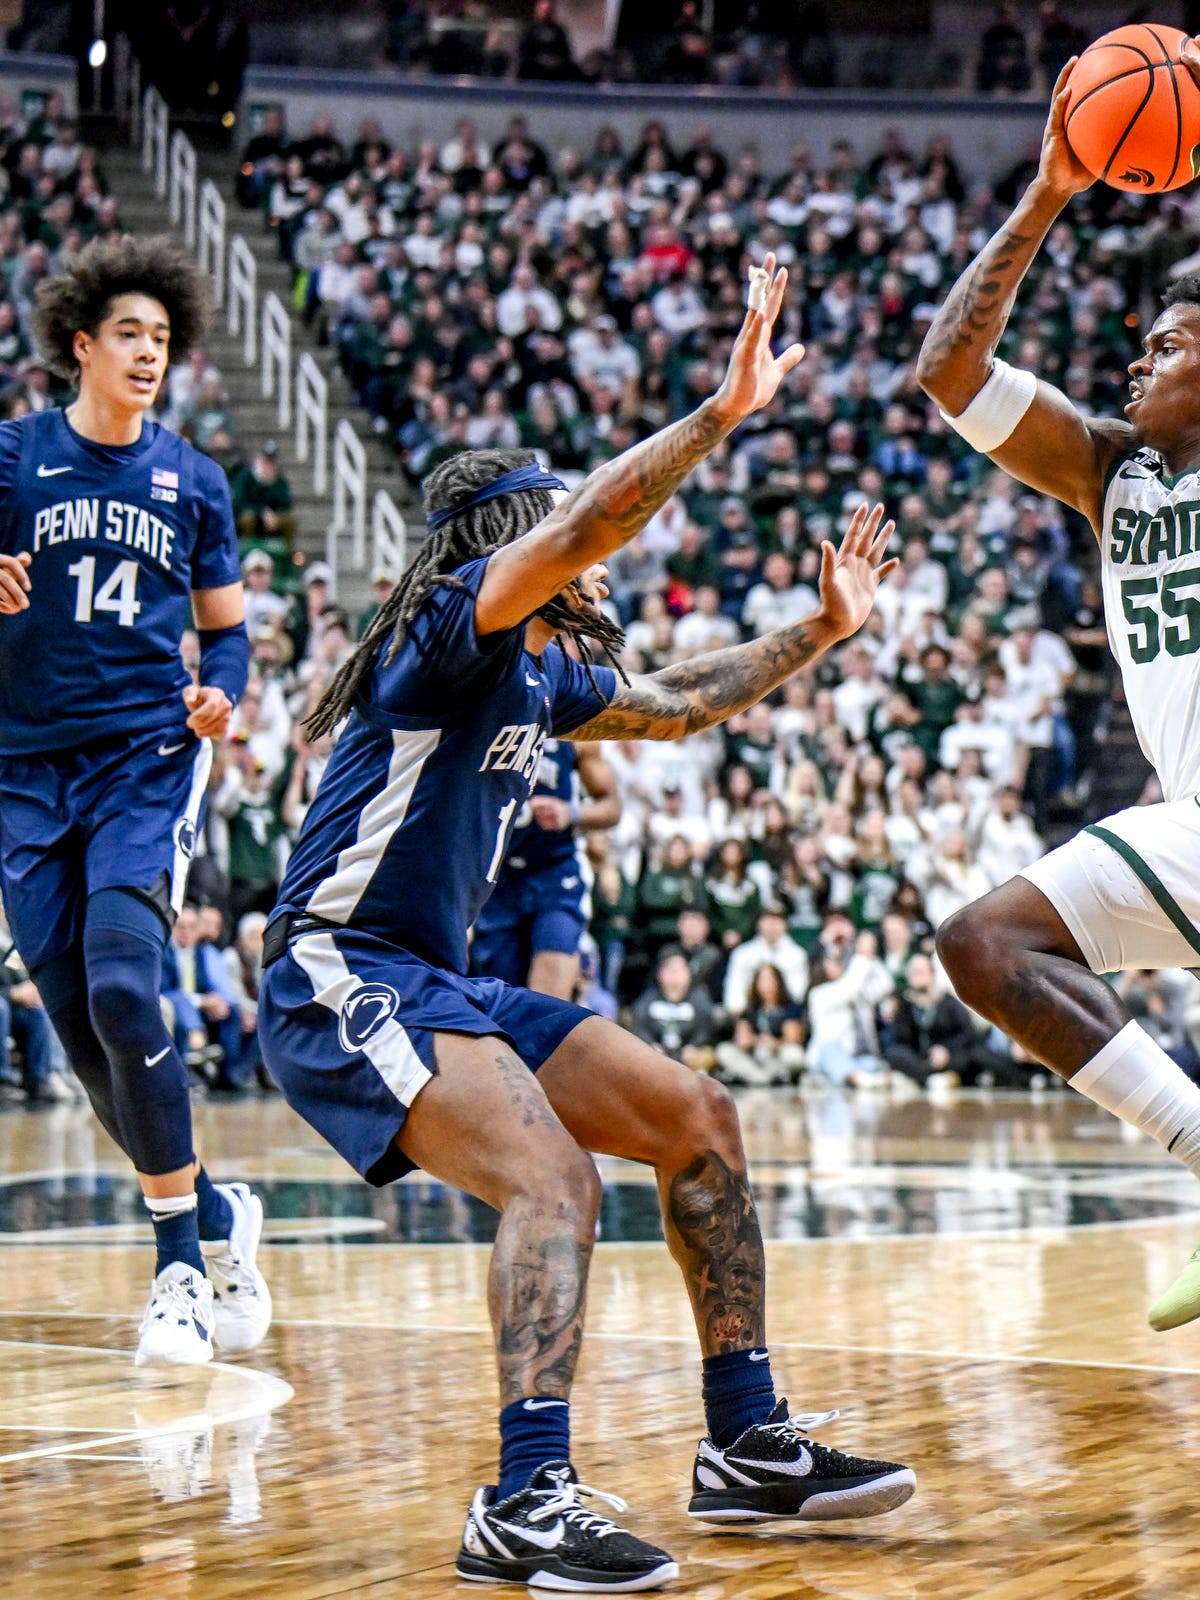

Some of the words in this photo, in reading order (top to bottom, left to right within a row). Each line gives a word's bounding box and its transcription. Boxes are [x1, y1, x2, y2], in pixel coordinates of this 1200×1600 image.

[33, 498, 100, 553] PENN
[105, 500, 176, 571] STATE
[68, 555, 142, 627] 14
